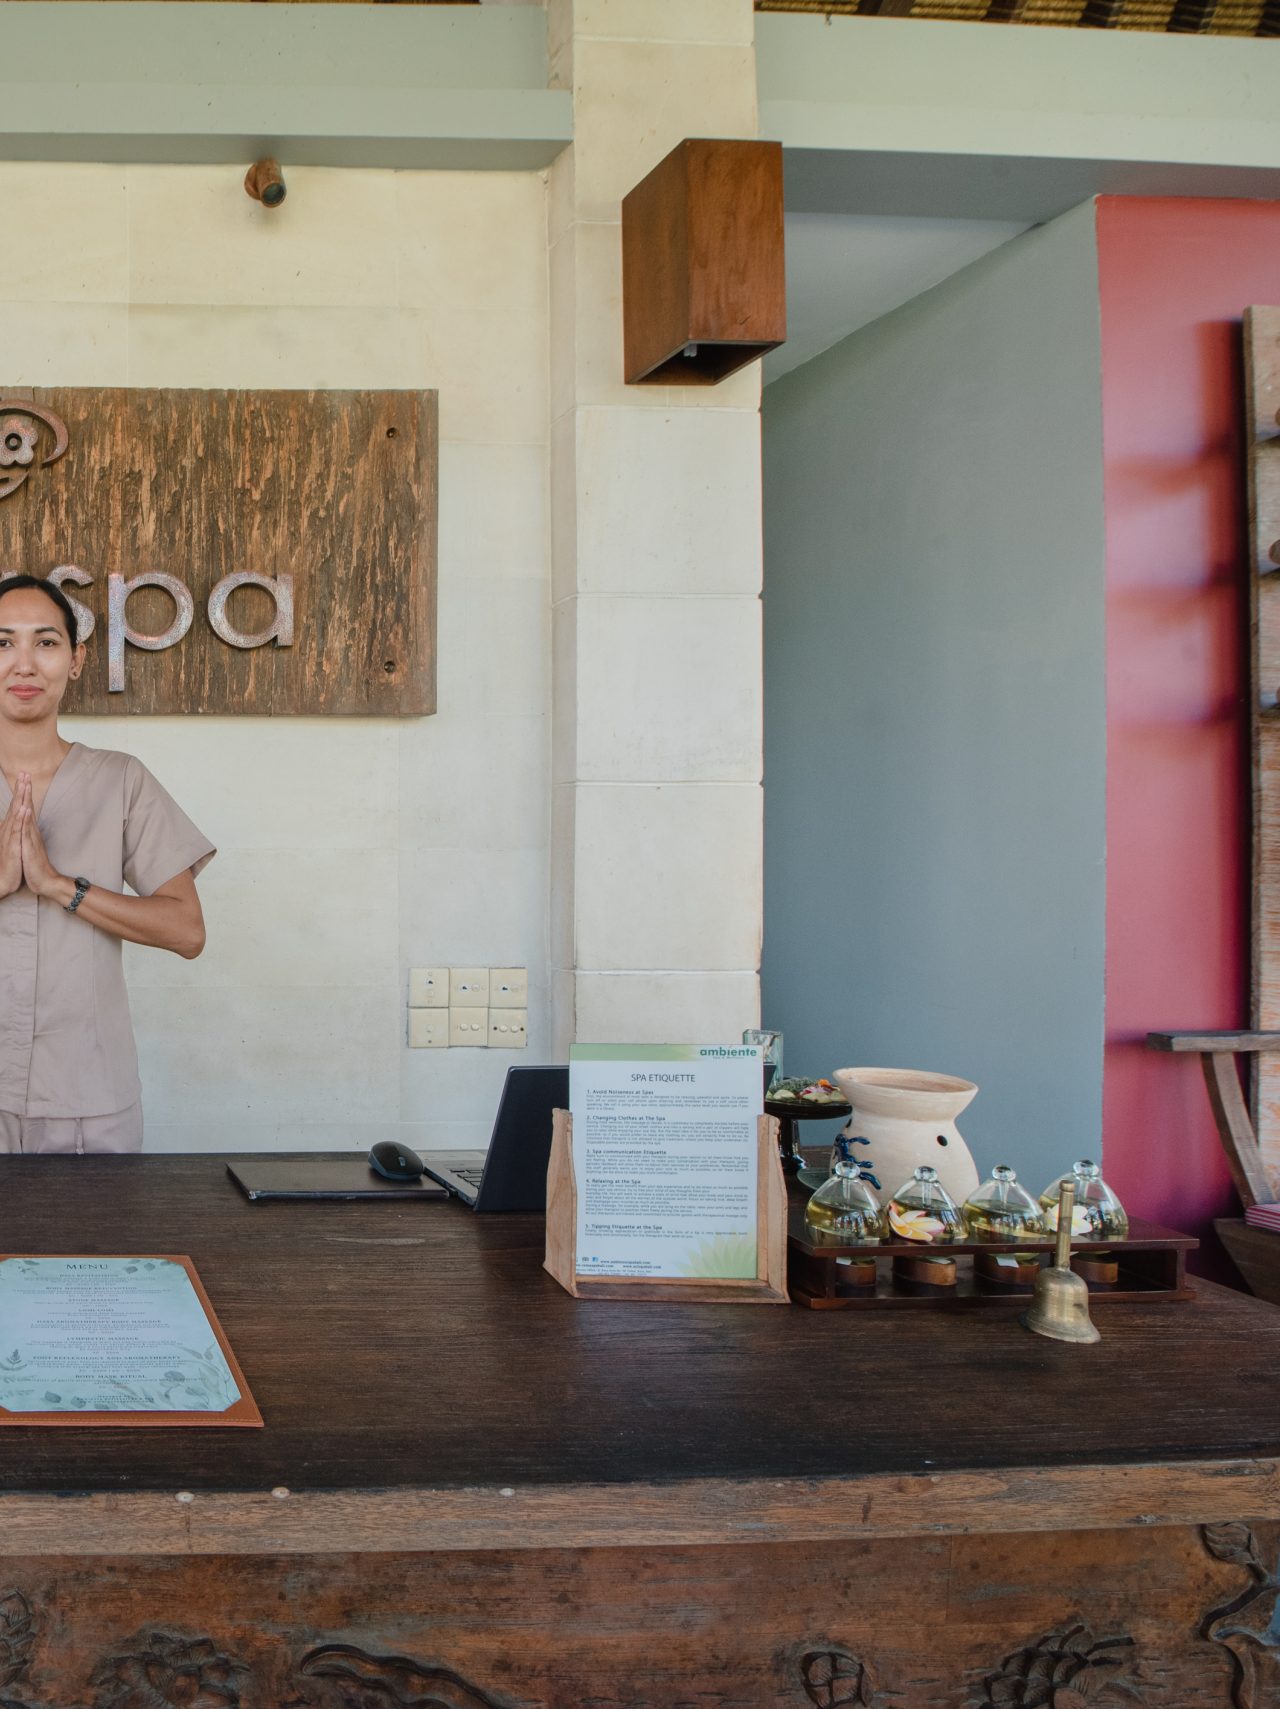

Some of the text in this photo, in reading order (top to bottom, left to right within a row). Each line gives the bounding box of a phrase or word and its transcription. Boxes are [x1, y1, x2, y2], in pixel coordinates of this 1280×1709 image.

[700, 1046, 757, 1057] ambiente
[631, 1074, 696, 1083] SPA ETIQUETTE
